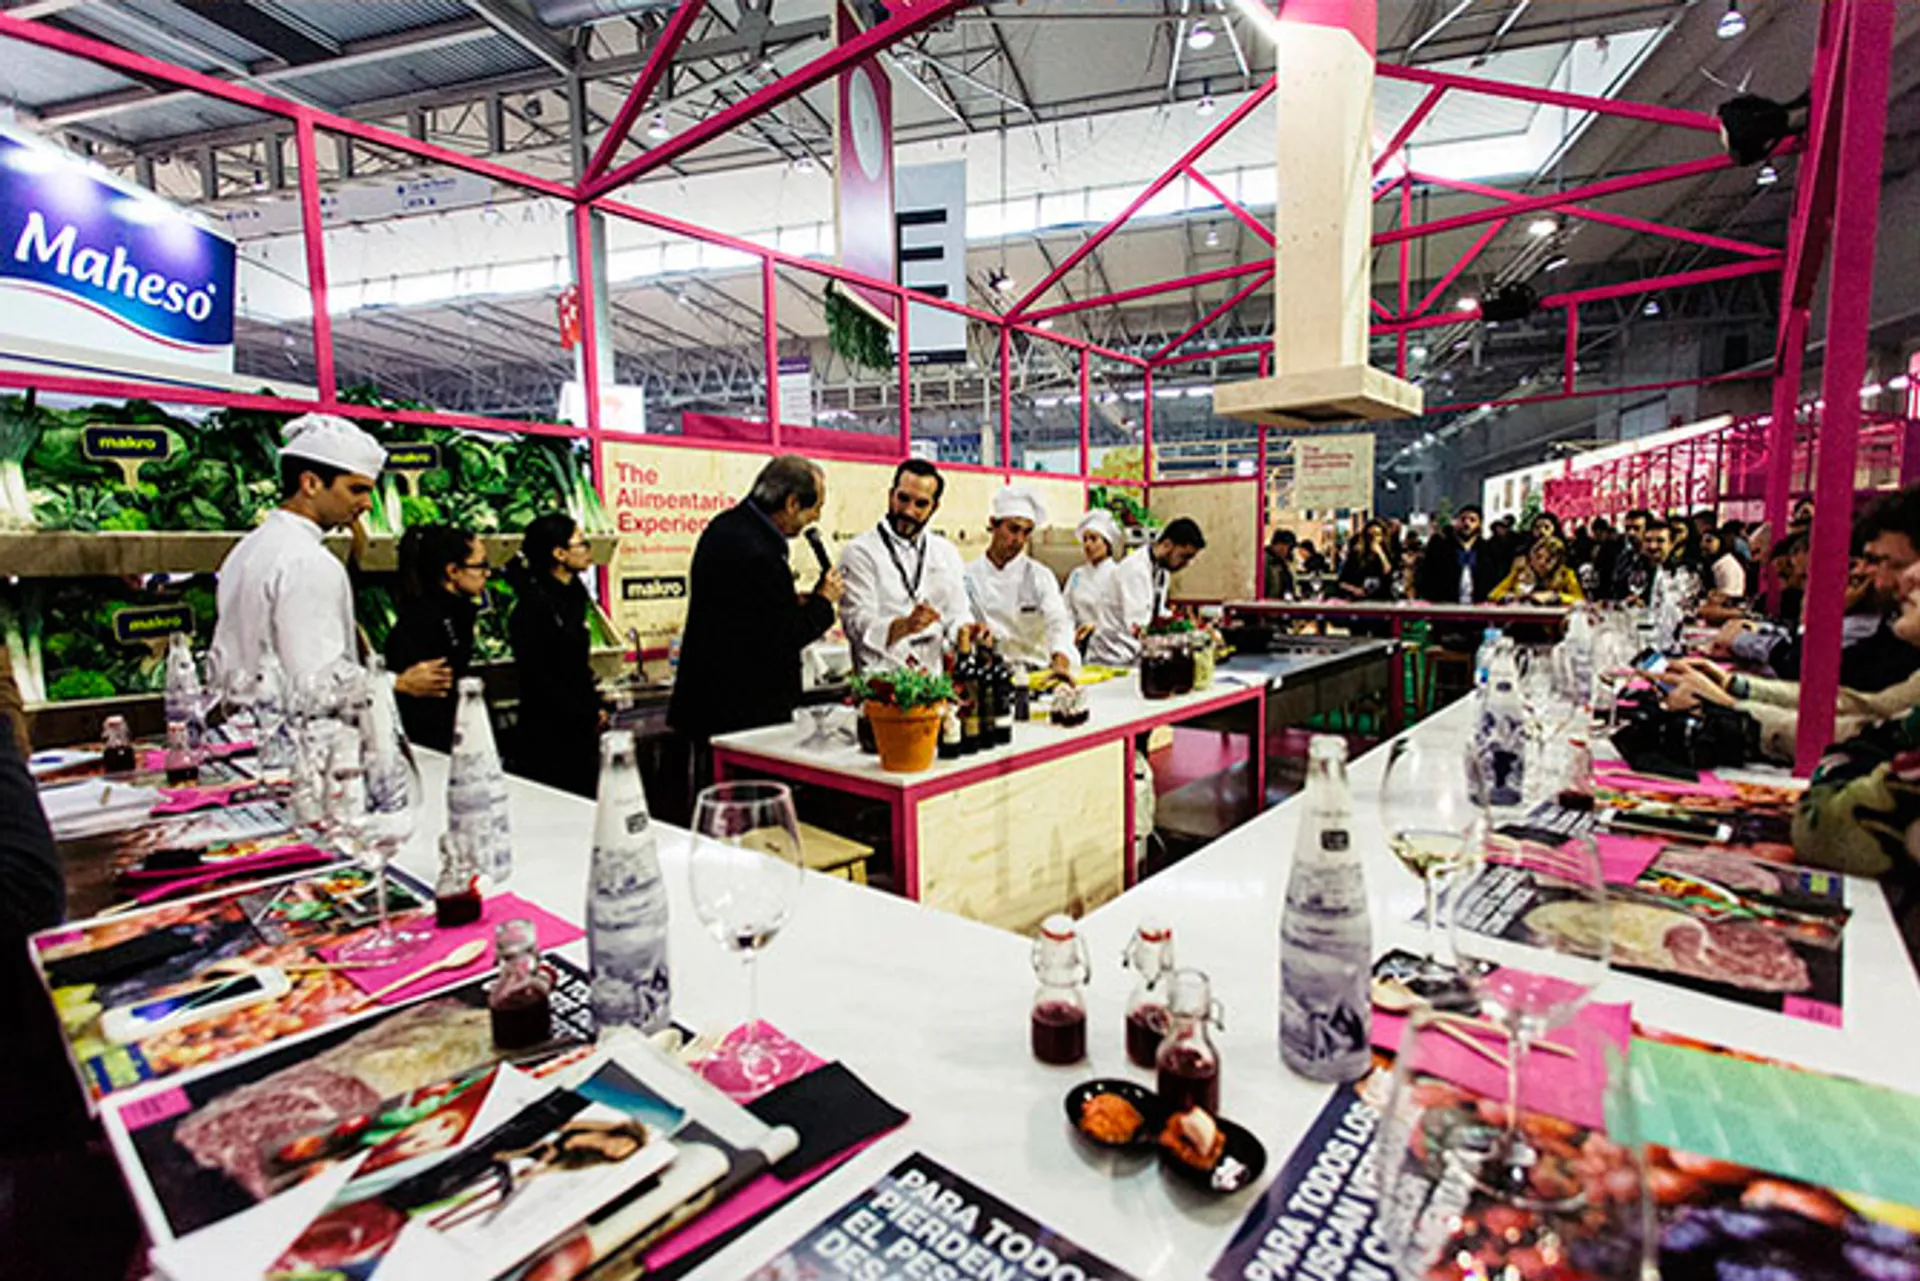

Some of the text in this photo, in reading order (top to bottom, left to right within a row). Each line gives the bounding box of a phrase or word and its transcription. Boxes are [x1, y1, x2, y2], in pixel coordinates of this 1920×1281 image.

[15, 211, 213, 322] Maheso
[895, 209, 947, 300] E
[98, 435, 156, 451] makro
[616, 461, 659, 486] The
[627, 579, 684, 598] makro
[1286, 1137, 1358, 1217] TODOS
[1334, 1101, 1381, 1145] LOS
[842, 1208, 887, 1250] EL
[869, 1188, 1017, 1281] PIERDEN
[896, 1168, 1100, 1281] PARA TODO
